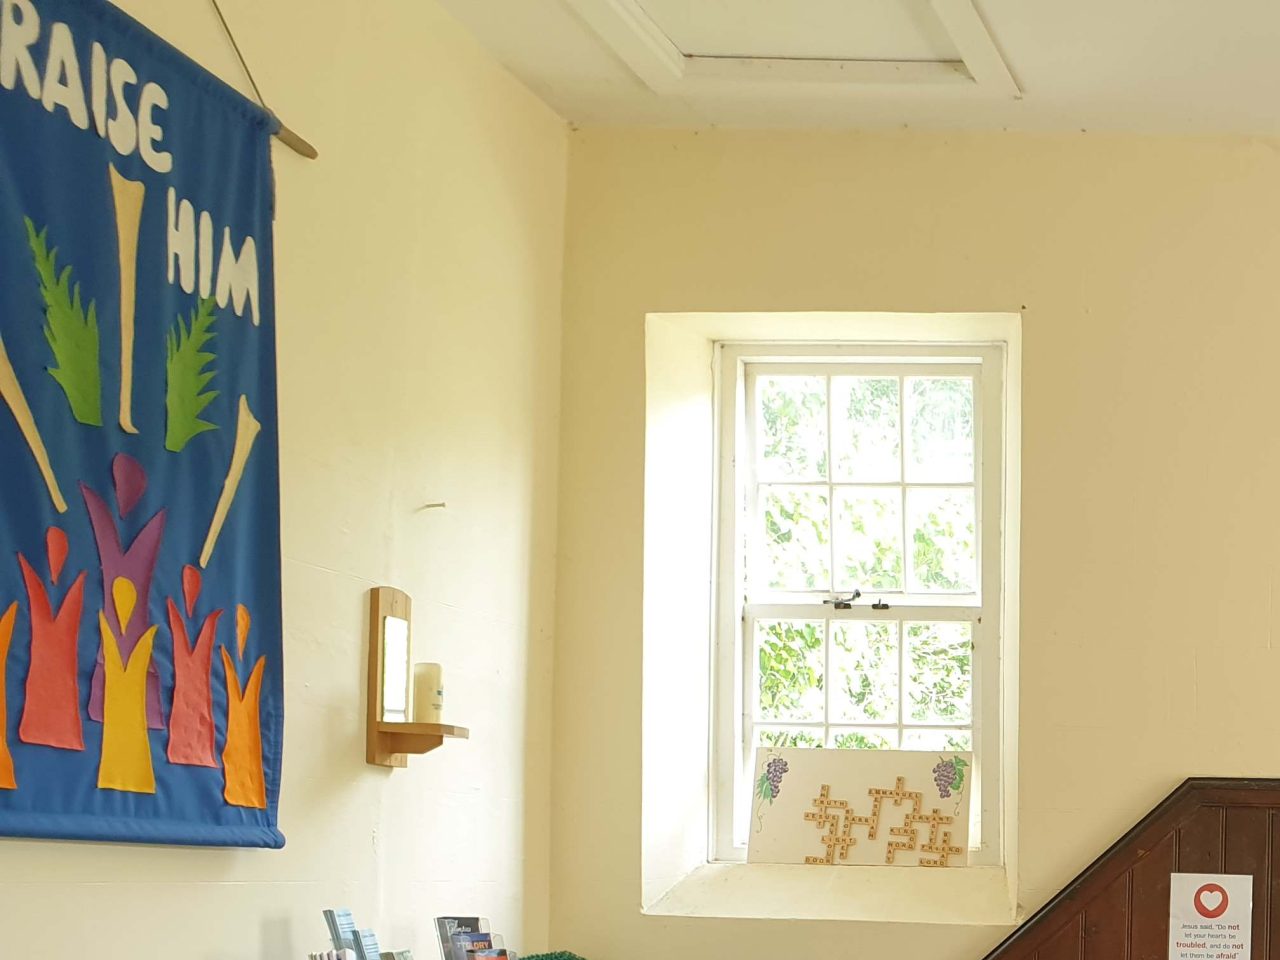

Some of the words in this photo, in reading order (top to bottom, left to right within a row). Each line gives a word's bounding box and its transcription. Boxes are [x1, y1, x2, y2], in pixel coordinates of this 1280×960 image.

[167, 186, 260, 326] HIM
[868, 789, 919, 798] EMMANUEL
[813, 798, 846, 807] TRUTH
[804, 812, 837, 821] JESUS
[821, 835, 853, 844] LIGHT
[887, 841, 914, 849] WORD
[805, 856, 831, 864] DOOR
